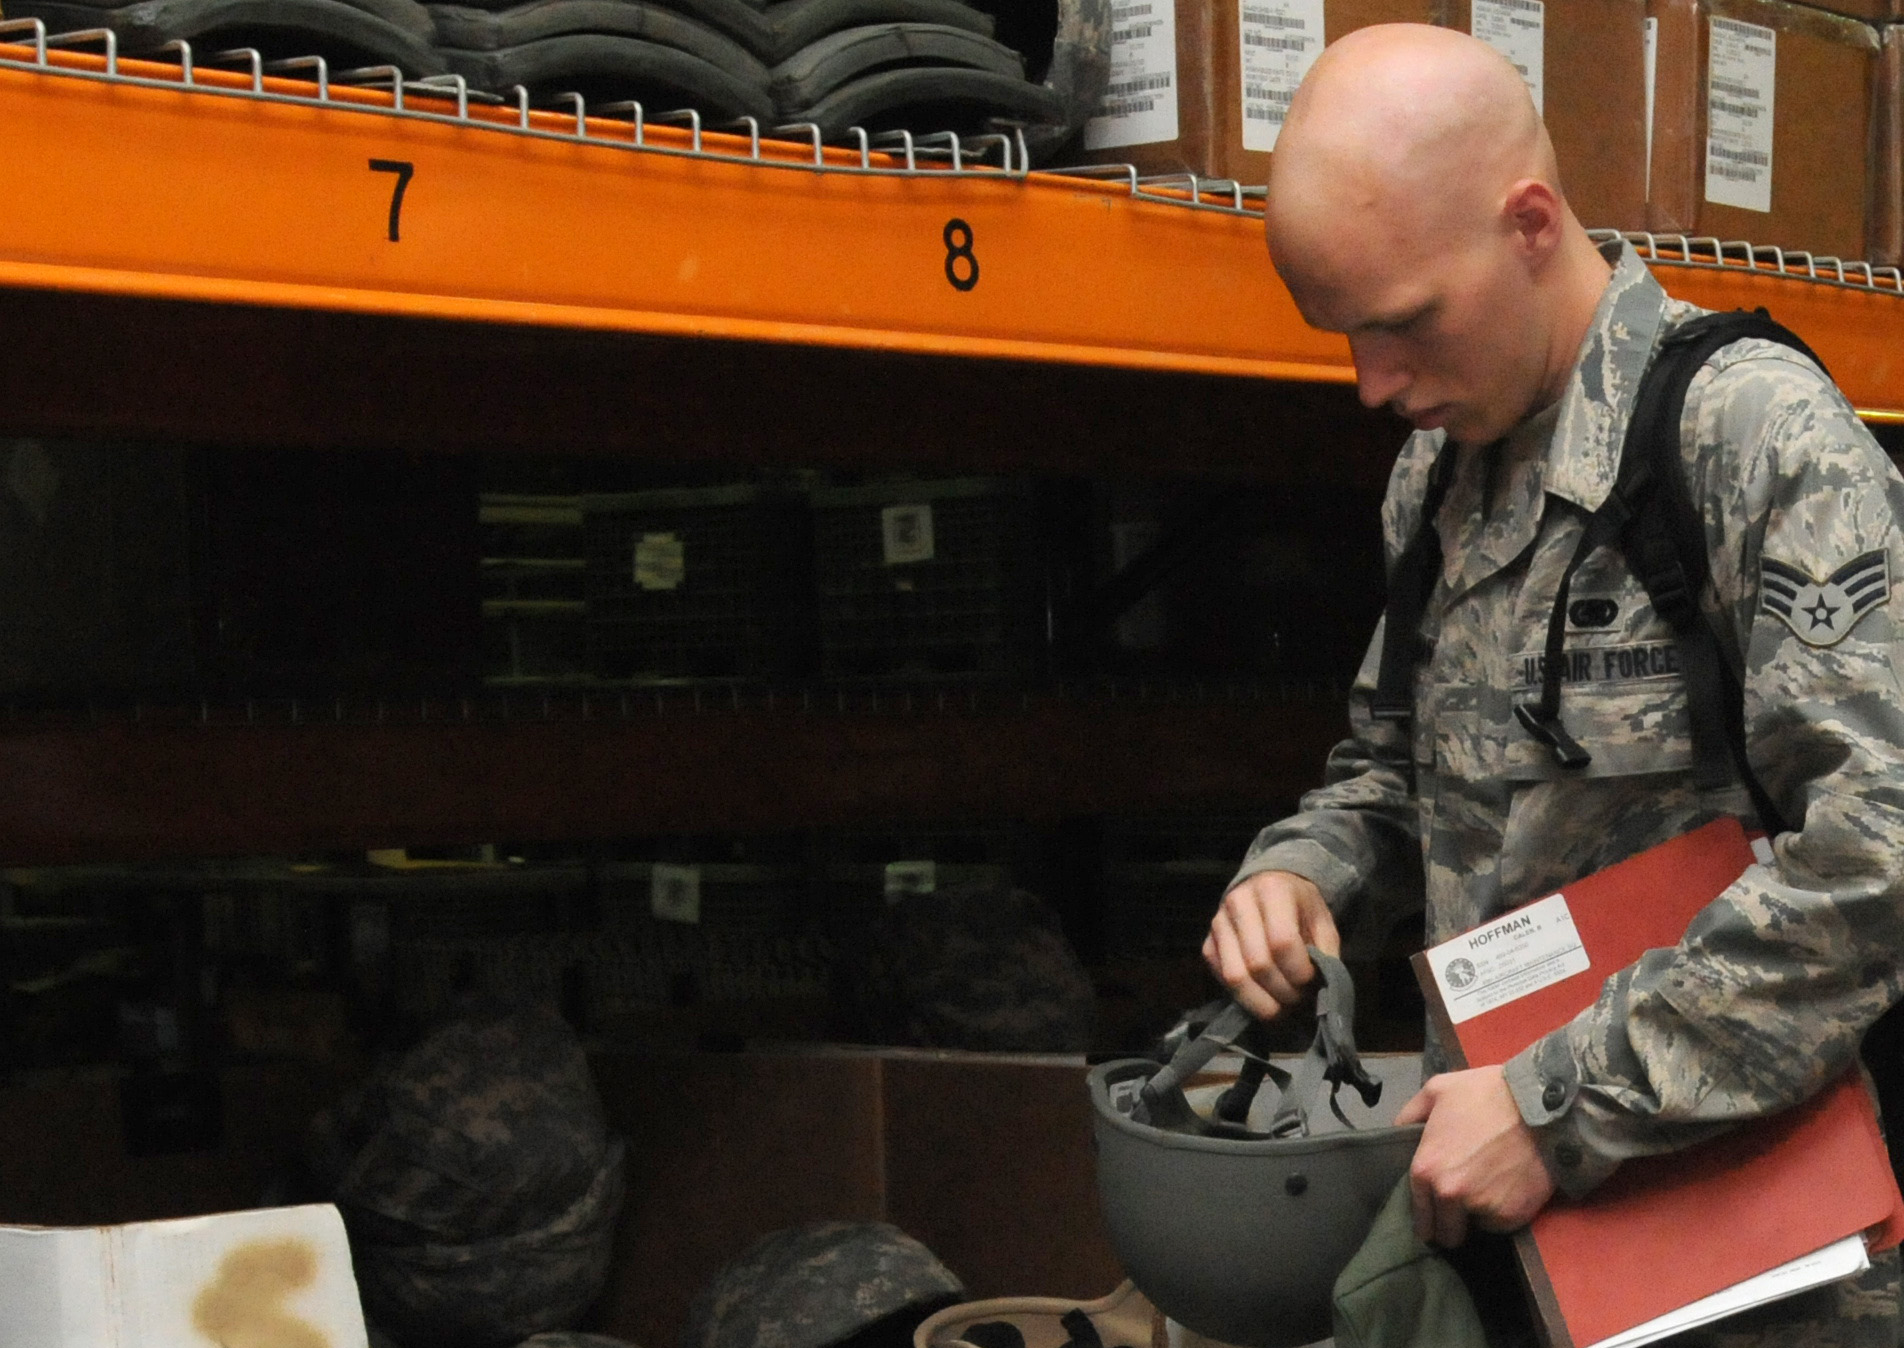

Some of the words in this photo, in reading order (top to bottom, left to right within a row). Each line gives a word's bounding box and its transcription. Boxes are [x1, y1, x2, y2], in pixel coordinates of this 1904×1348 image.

[367, 158, 413, 242] 7
[943, 218, 980, 292] 8
[1604, 644, 1681, 680] FORCE
[1468, 915, 1531, 950] HOFFMAN
